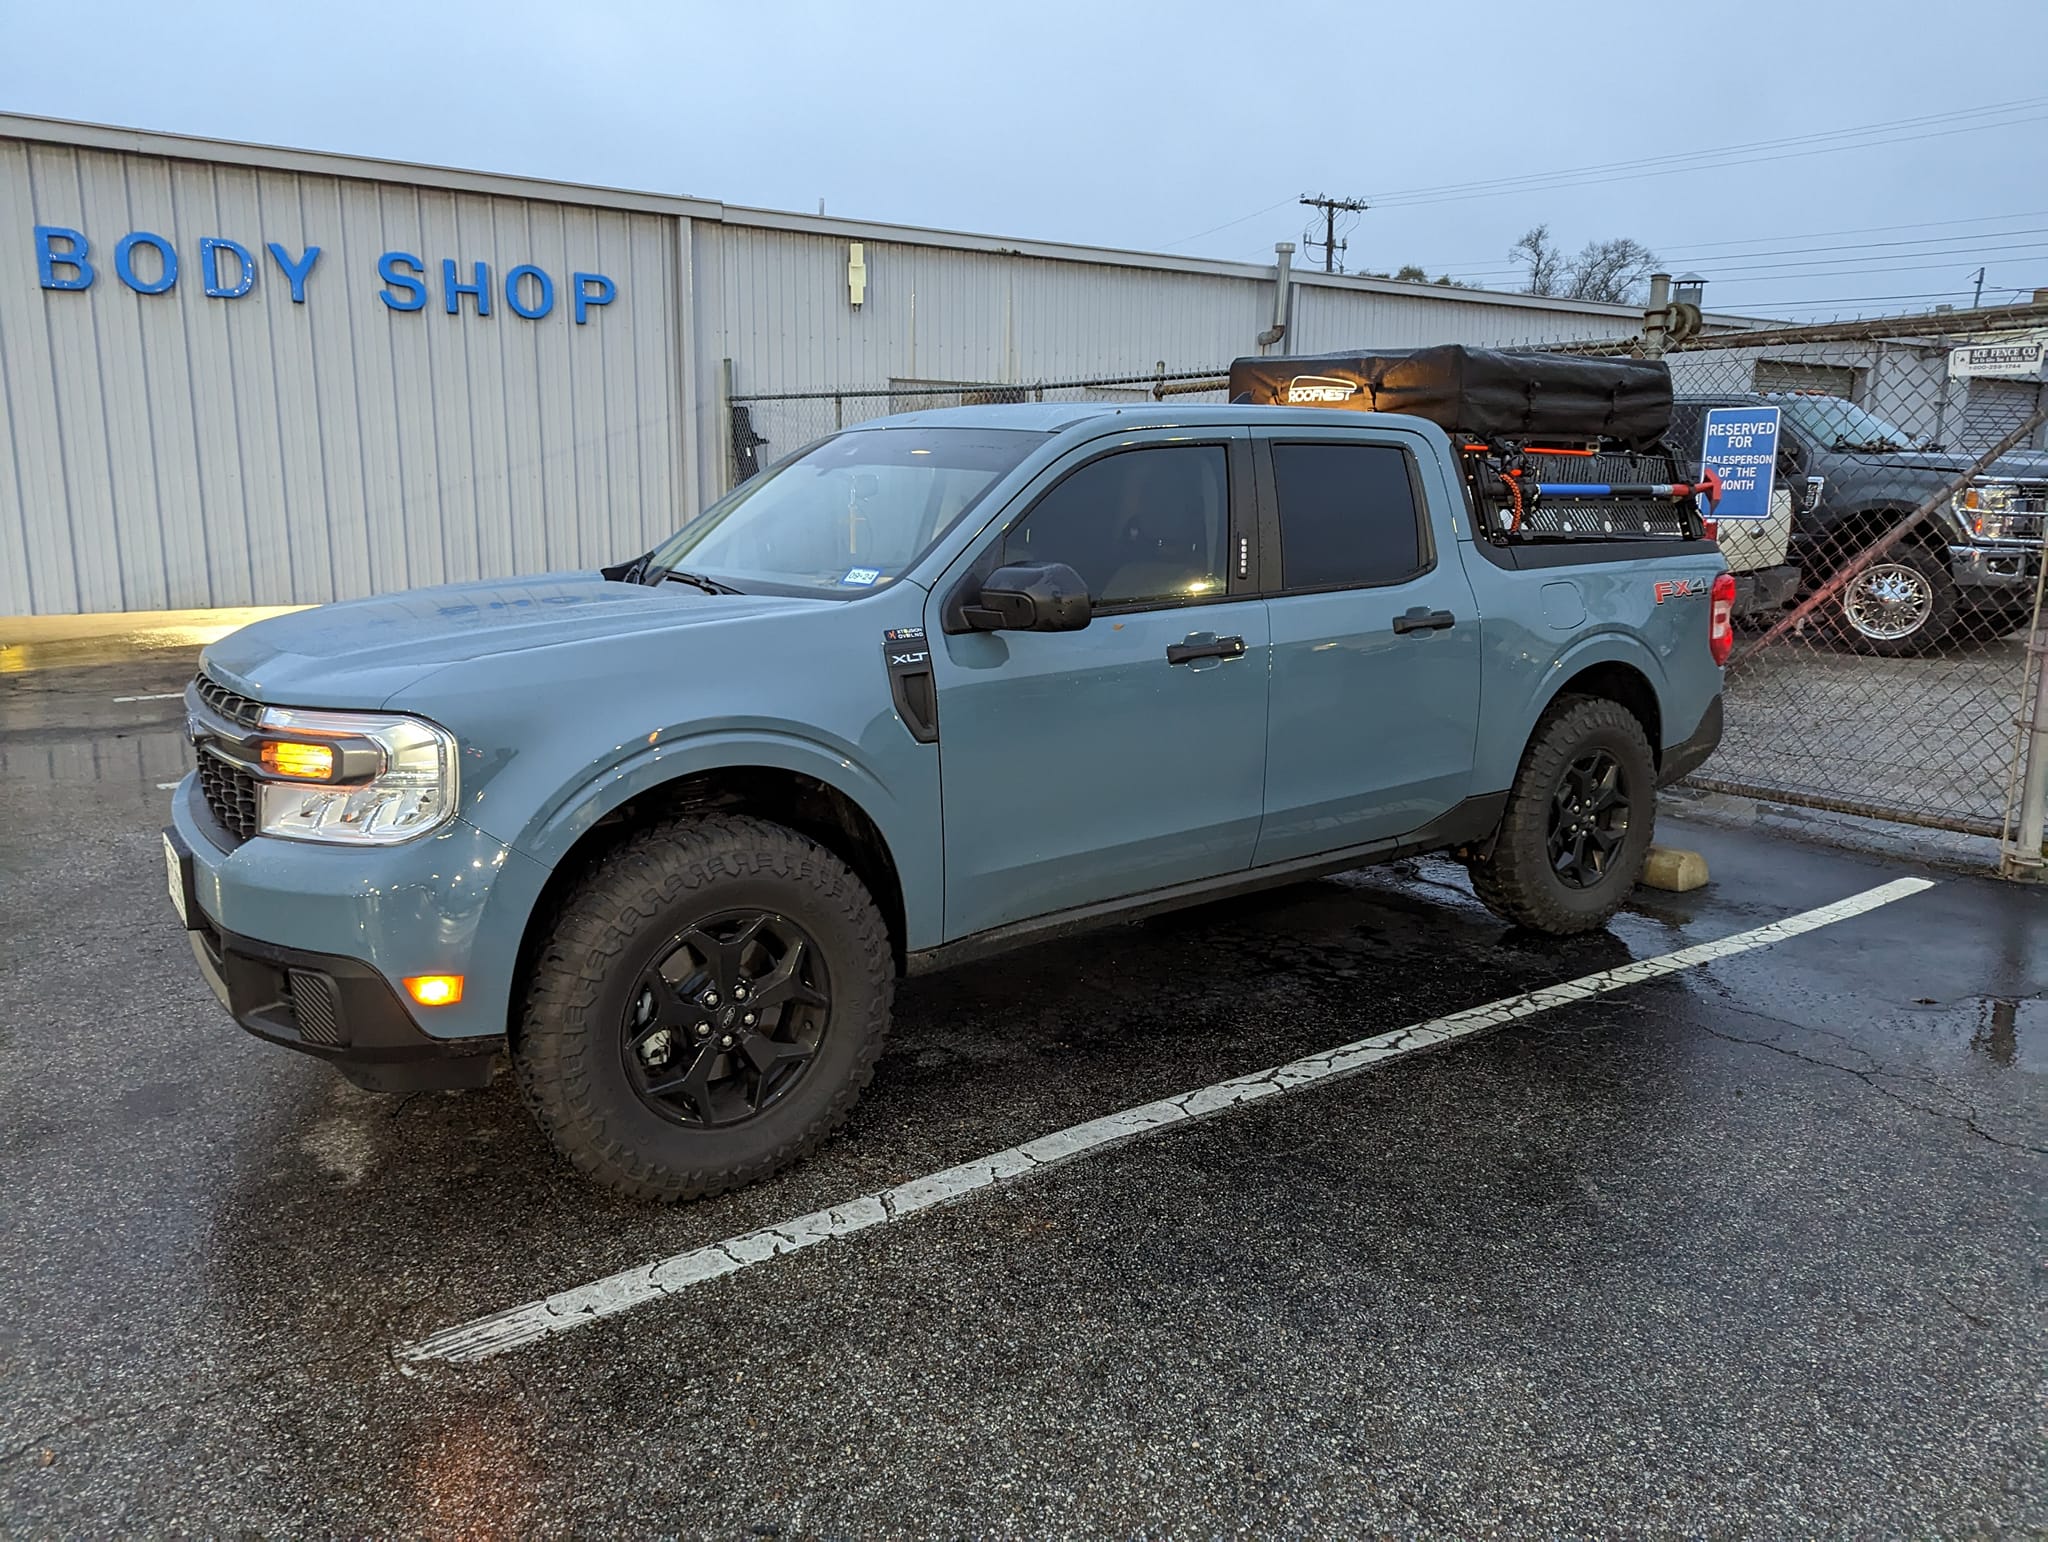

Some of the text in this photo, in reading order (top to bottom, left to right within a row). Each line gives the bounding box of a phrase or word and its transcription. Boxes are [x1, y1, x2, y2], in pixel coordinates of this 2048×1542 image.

[34, 225, 617, 325] BODY SHOP
[1972, 349, 1988, 358] ACE
[1990, 347, 2018, 357] FENCE
[1288, 389, 1356, 403] ROOFNEST
[1708, 422, 1775, 436] RESERVED
[1728, 436, 1753, 448] FOR
[1706, 454, 1774, 465] SALESPERSON
[1718, 467, 1757, 478] OF THE
[1653, 576, 1708, 606] FX4
[892, 651, 929, 665] XLT
